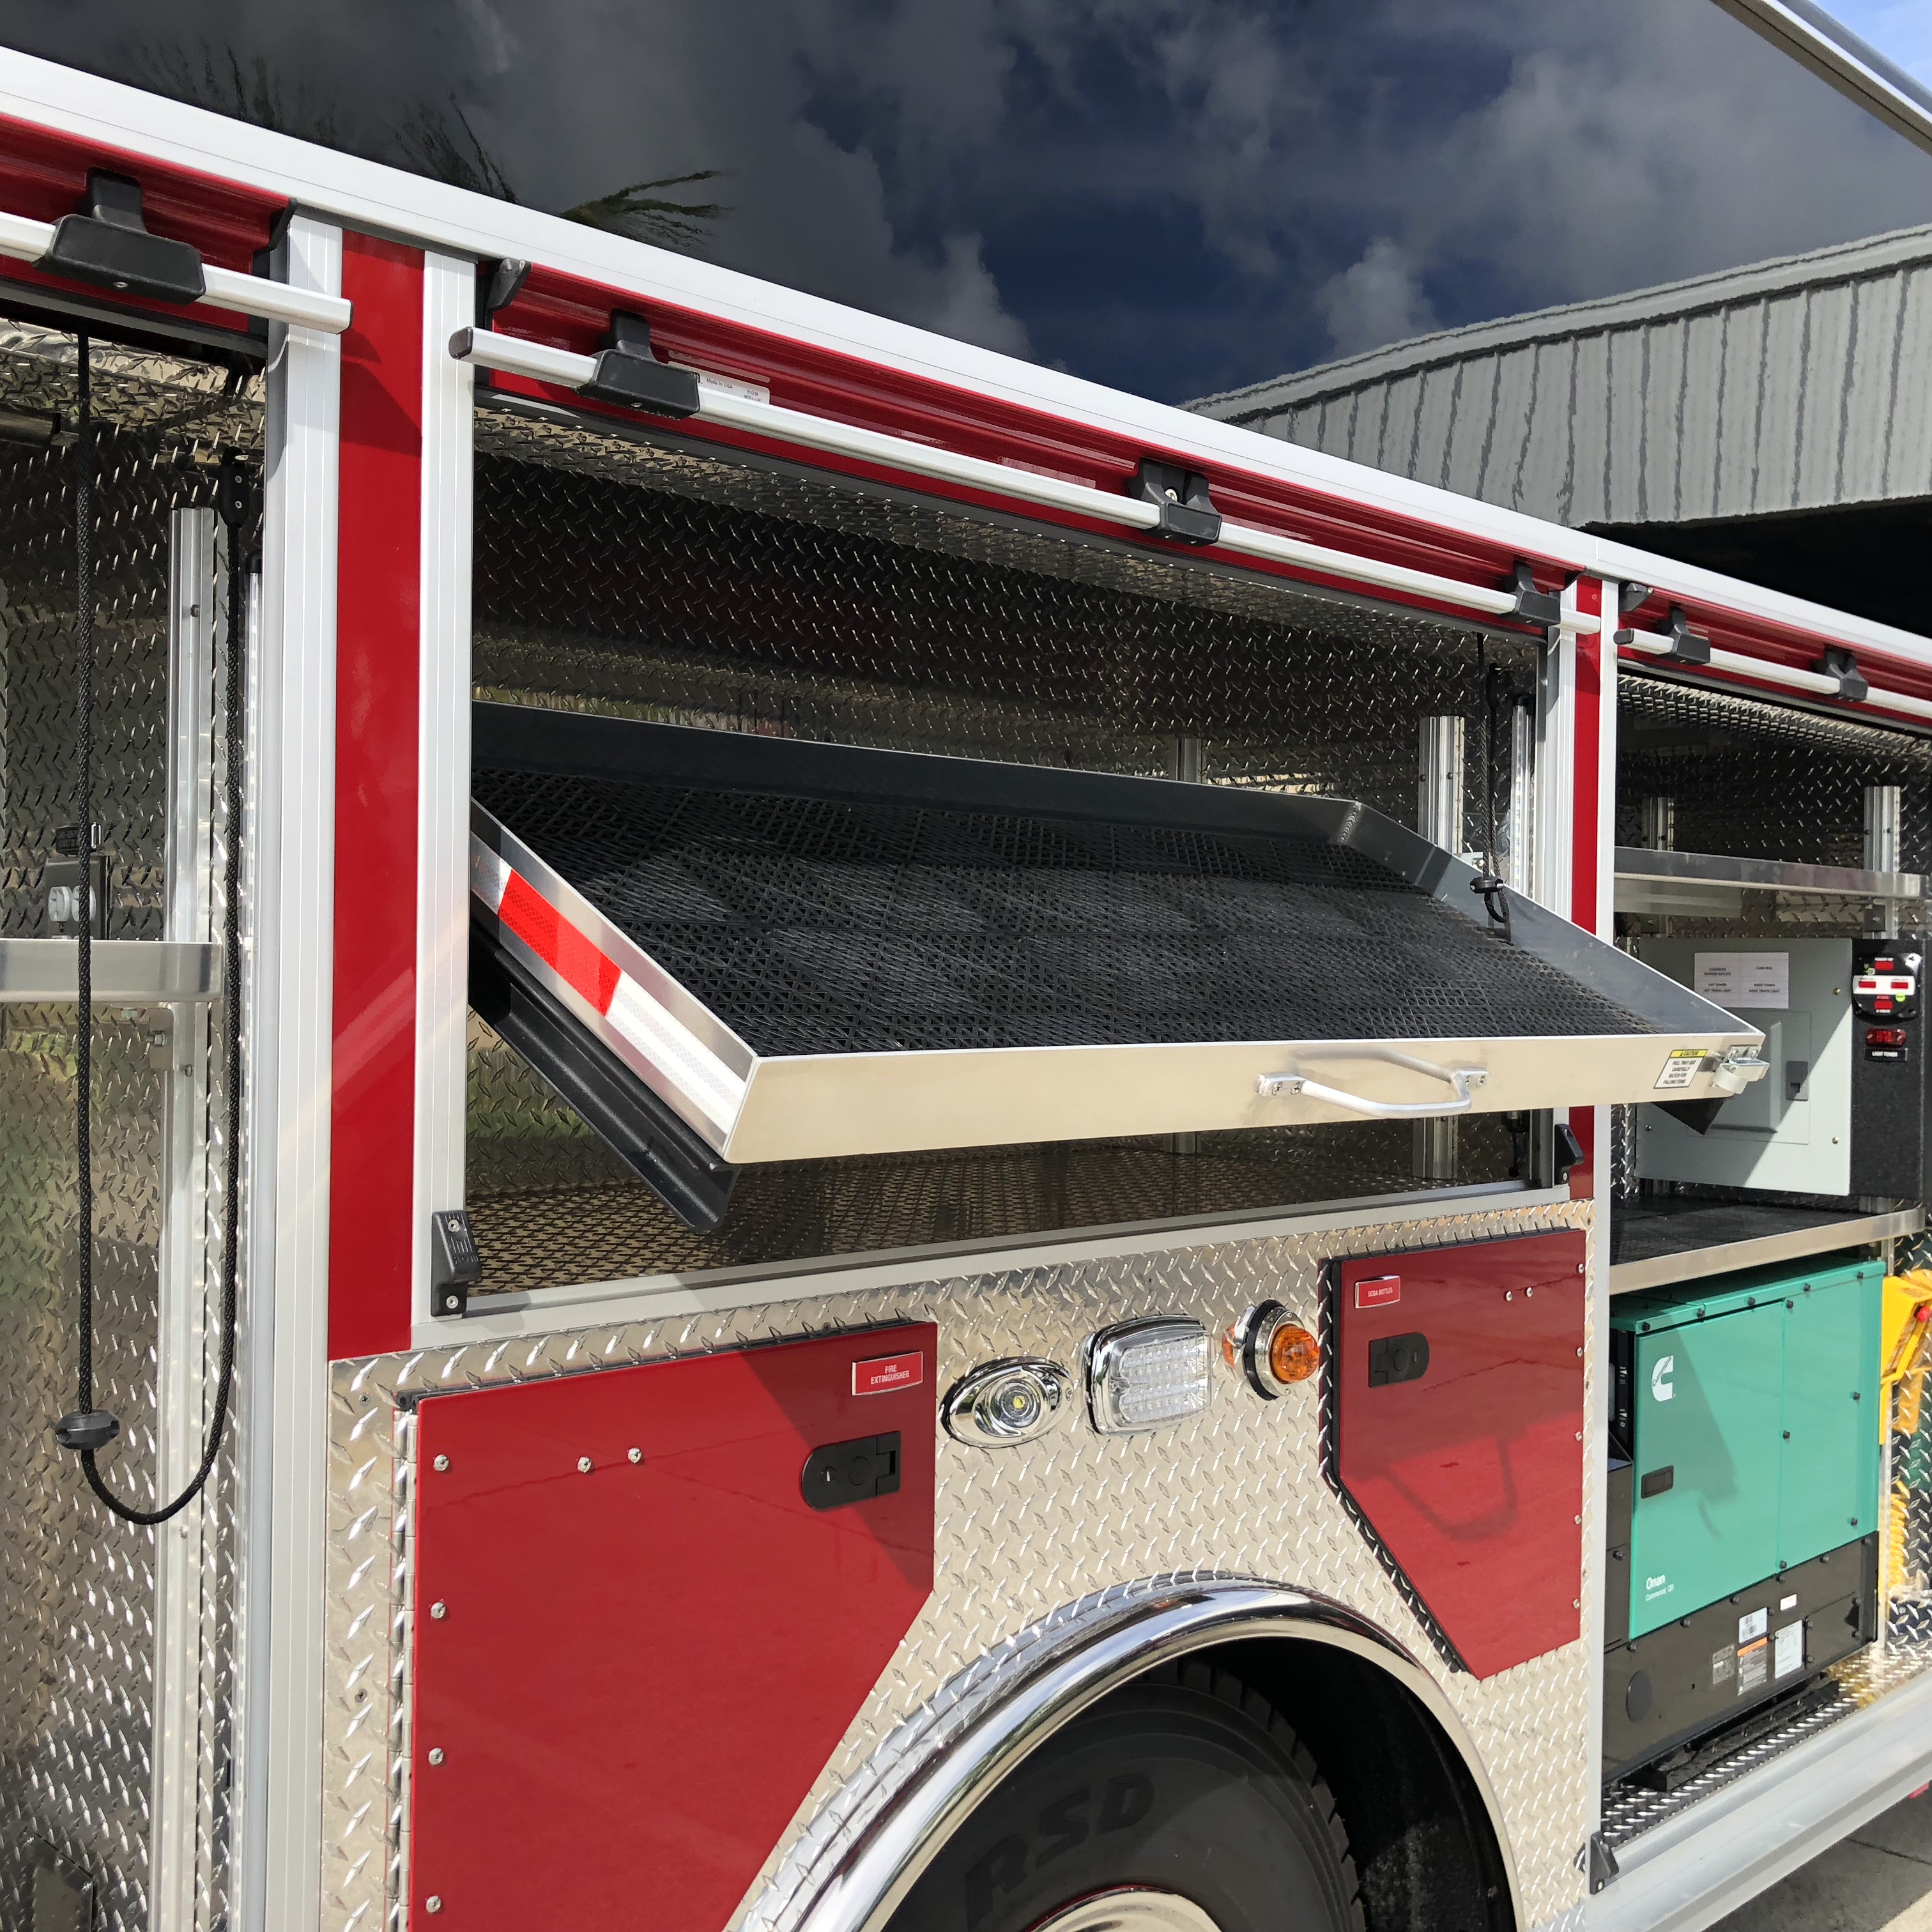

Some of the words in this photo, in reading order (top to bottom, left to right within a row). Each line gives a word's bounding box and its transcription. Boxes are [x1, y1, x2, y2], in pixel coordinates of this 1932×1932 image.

[885, 1364, 897, 1374] FIRE
[870, 1370, 910, 1384] EXTINGUISHER
[1645, 1574, 1666, 1590] Onan
[965, 1773, 1154, 1932] RSD
